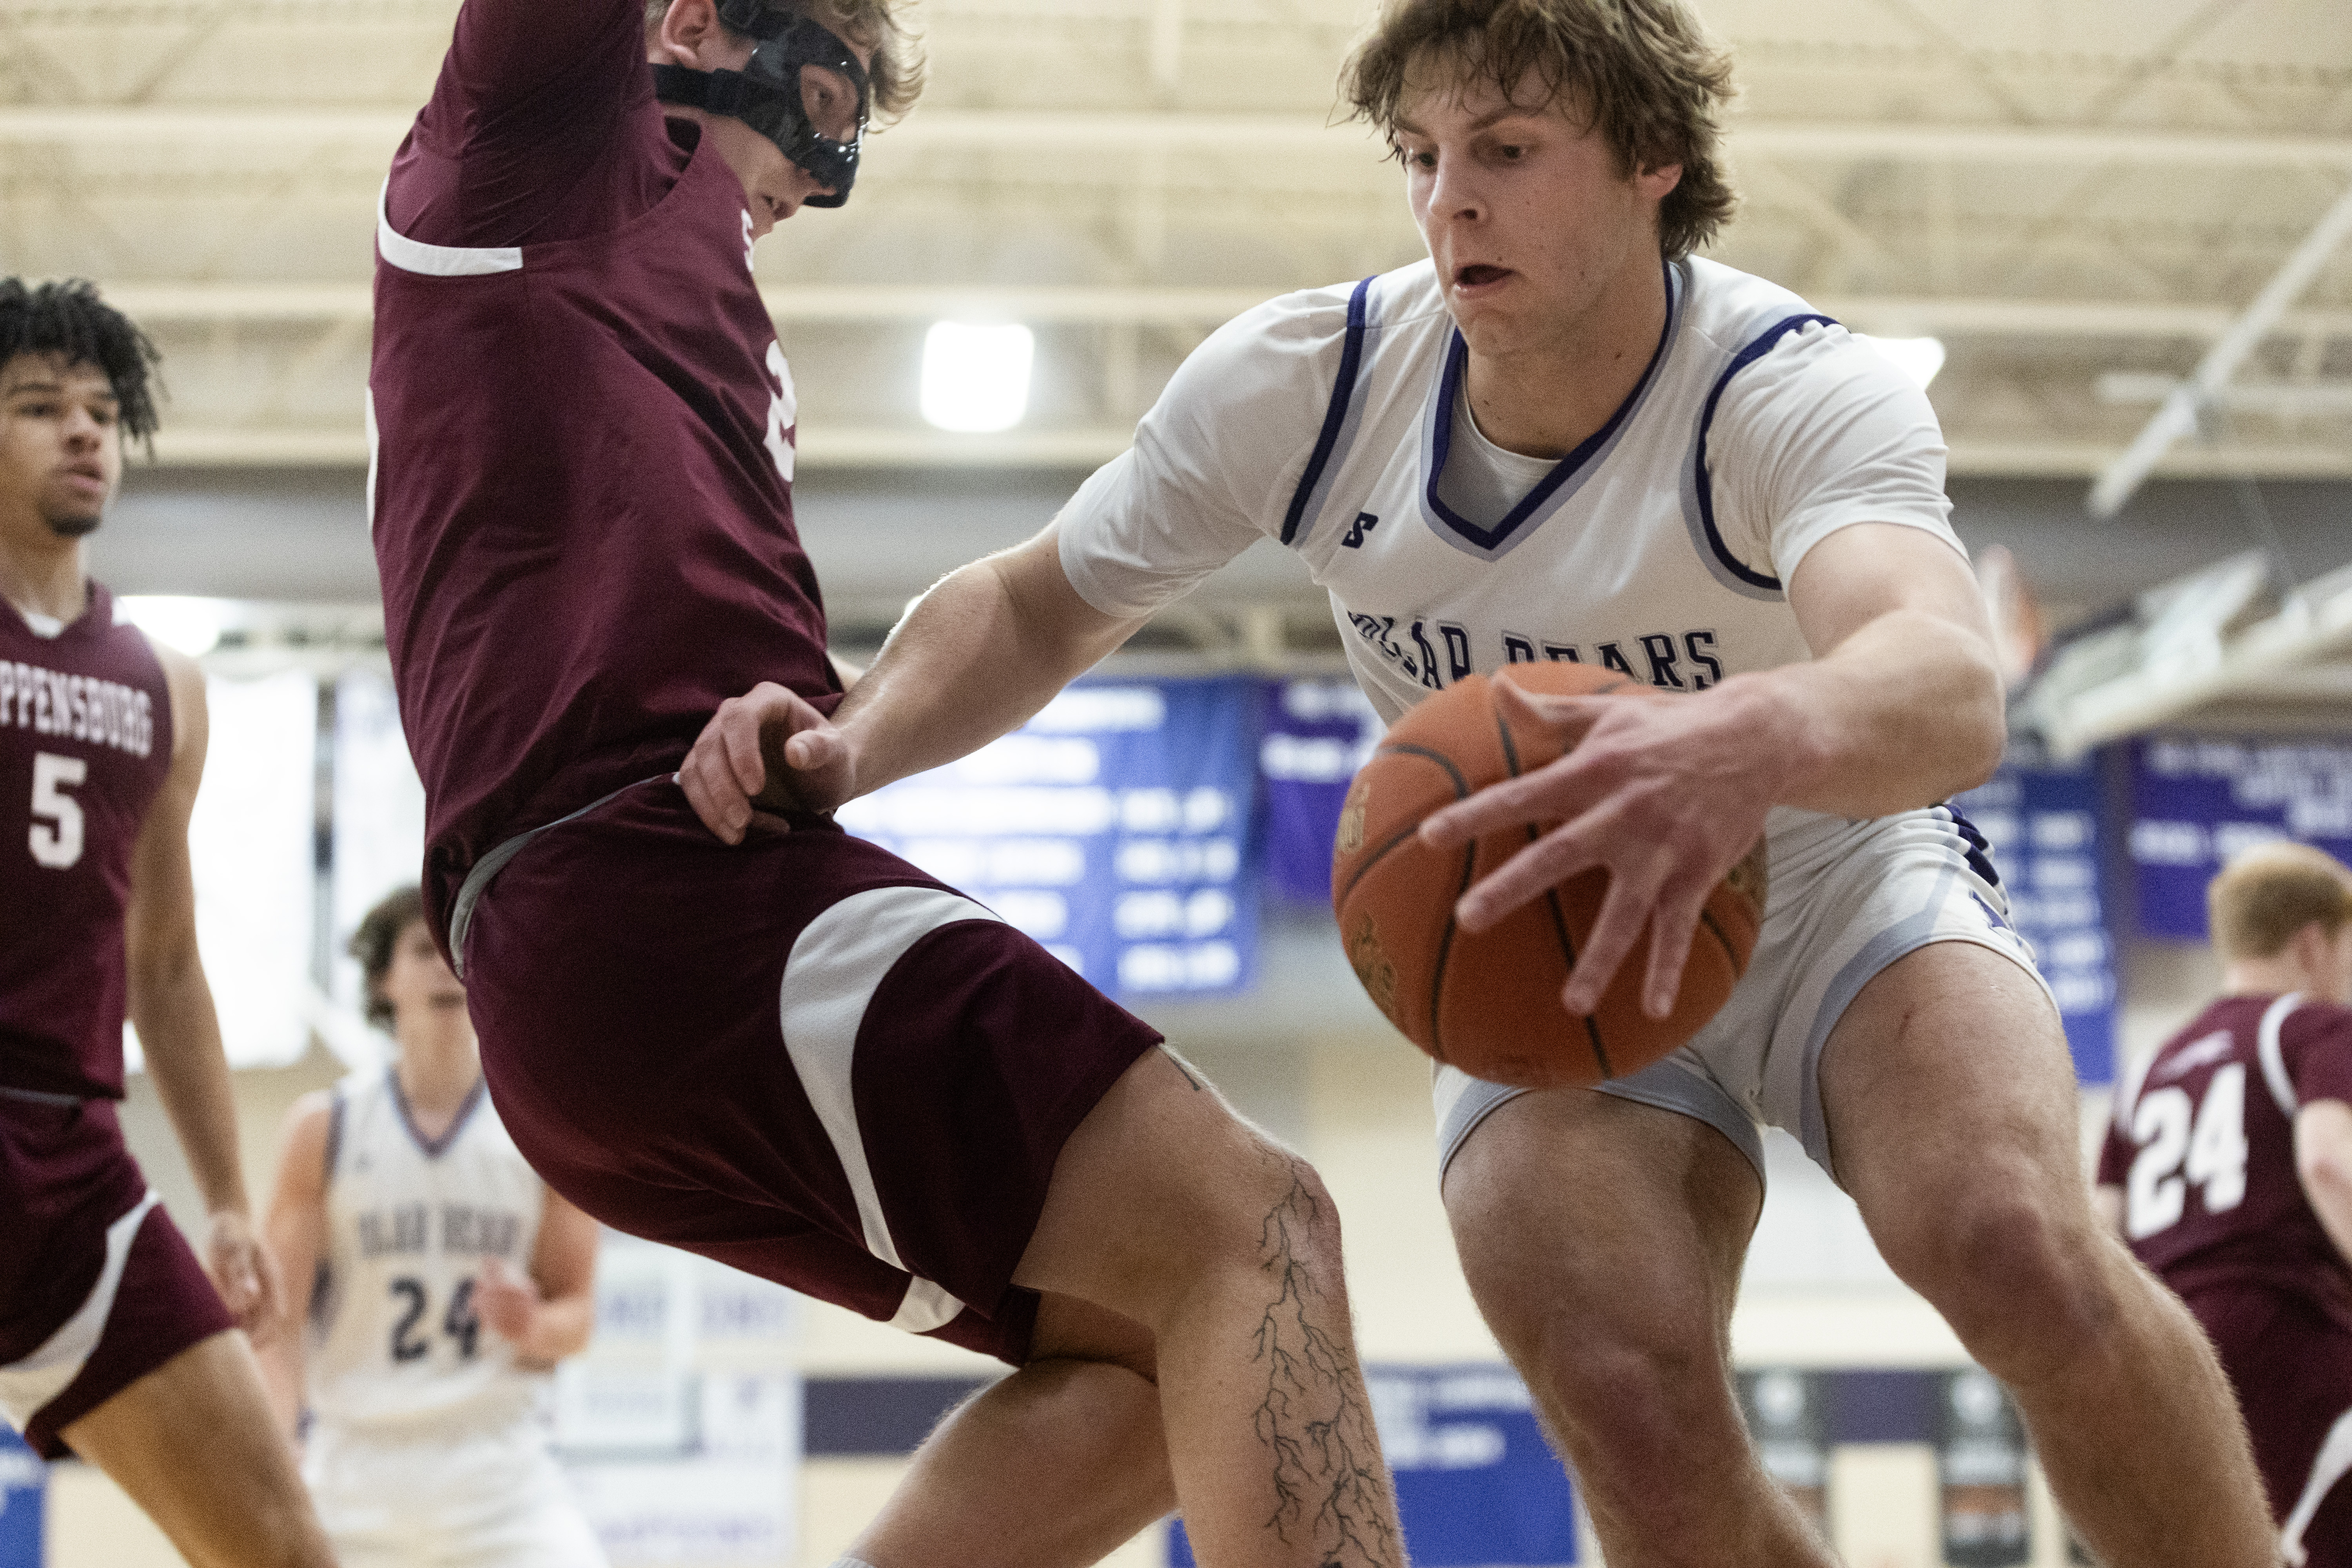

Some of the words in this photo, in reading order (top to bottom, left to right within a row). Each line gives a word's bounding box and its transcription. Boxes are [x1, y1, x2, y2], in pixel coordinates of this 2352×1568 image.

[28, 751, 87, 870] 5
[2127, 1061, 2249, 1240] 24
[389, 1276, 481, 1362] 24
